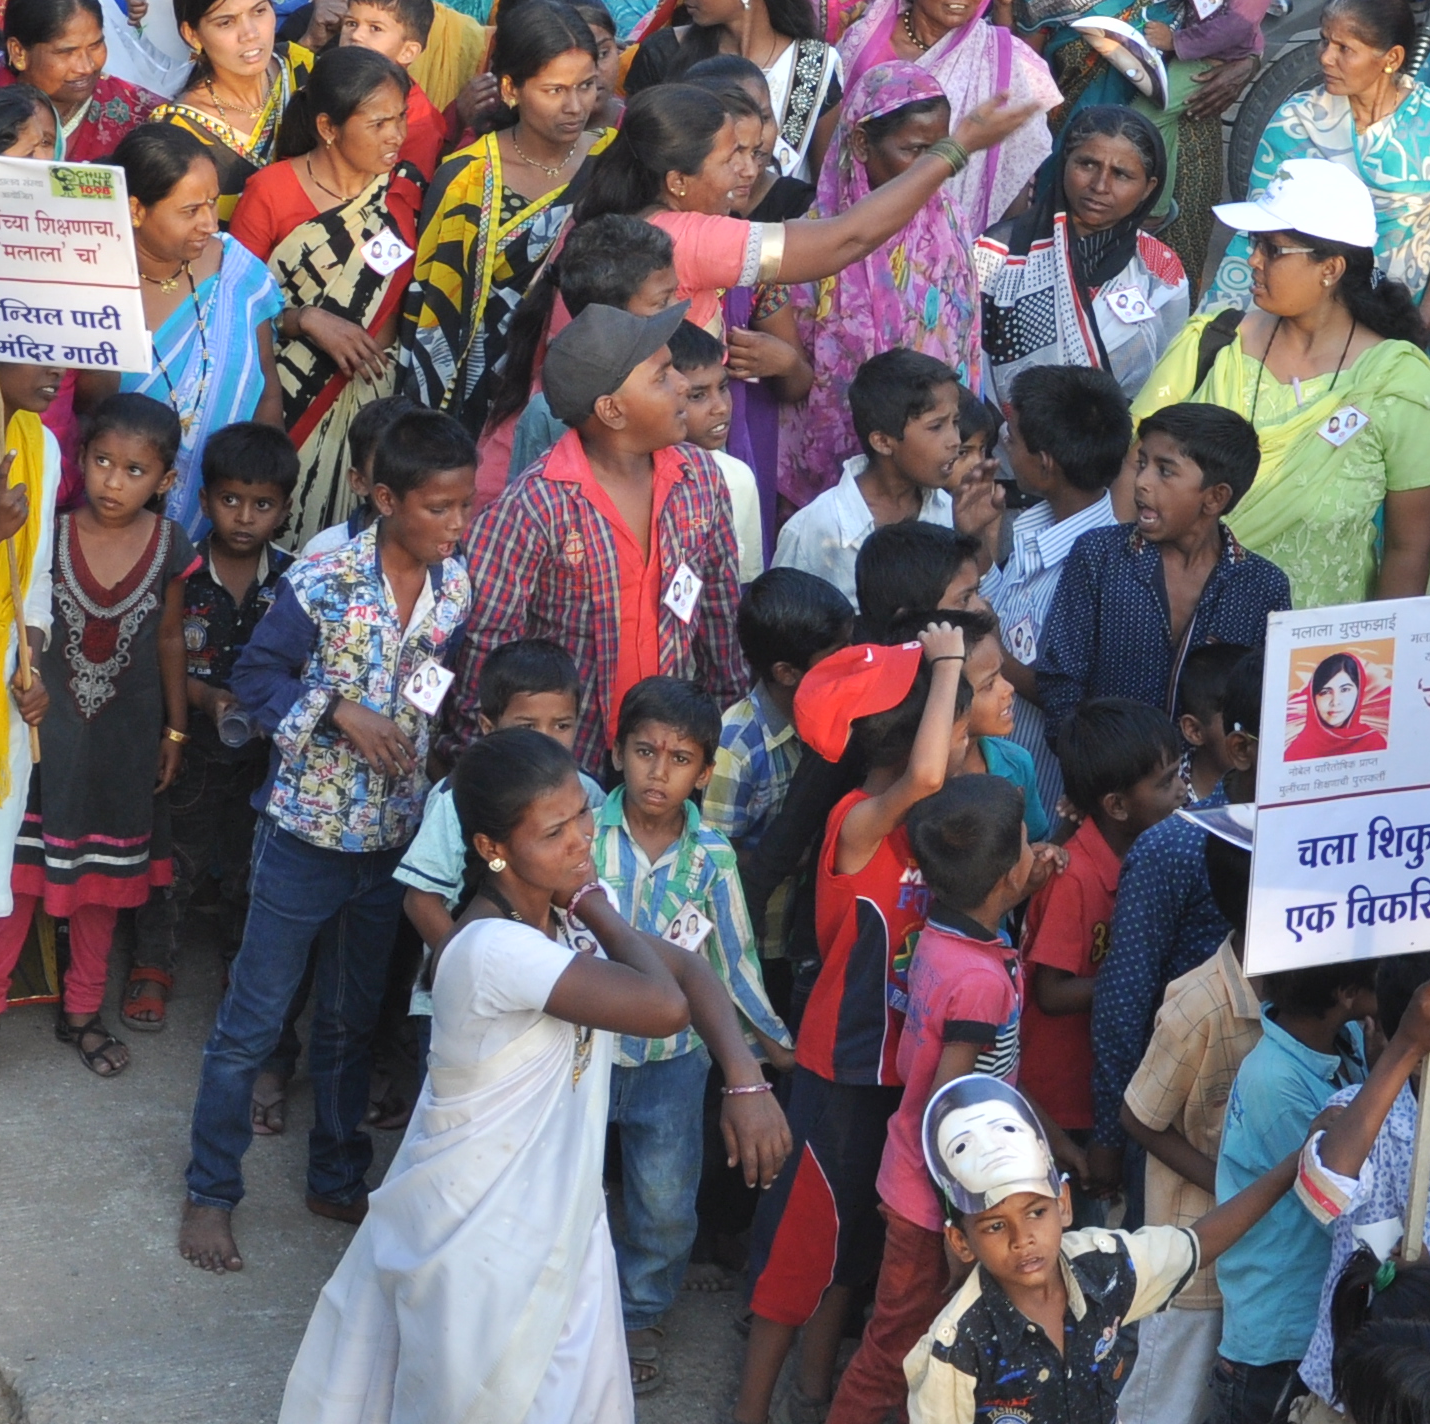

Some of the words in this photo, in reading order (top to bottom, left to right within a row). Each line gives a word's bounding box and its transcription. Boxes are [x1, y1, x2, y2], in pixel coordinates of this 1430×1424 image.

[75, 170, 112, 182] CHILD
[79, 184, 111, 196] 1098
[35, 209, 121, 242] शिक्षणाचा,
[70, 305, 122, 331] पाटी
[62, 341, 119, 366] गाठी
[1291, 624, 1333, 640] मलाला
[1339, 613, 1397, 639] युसुफझाई
[1297, 832, 1359, 869] चला
[1285, 902, 1338, 943] एक
[987, 1406, 1034, 1422] FASHION
